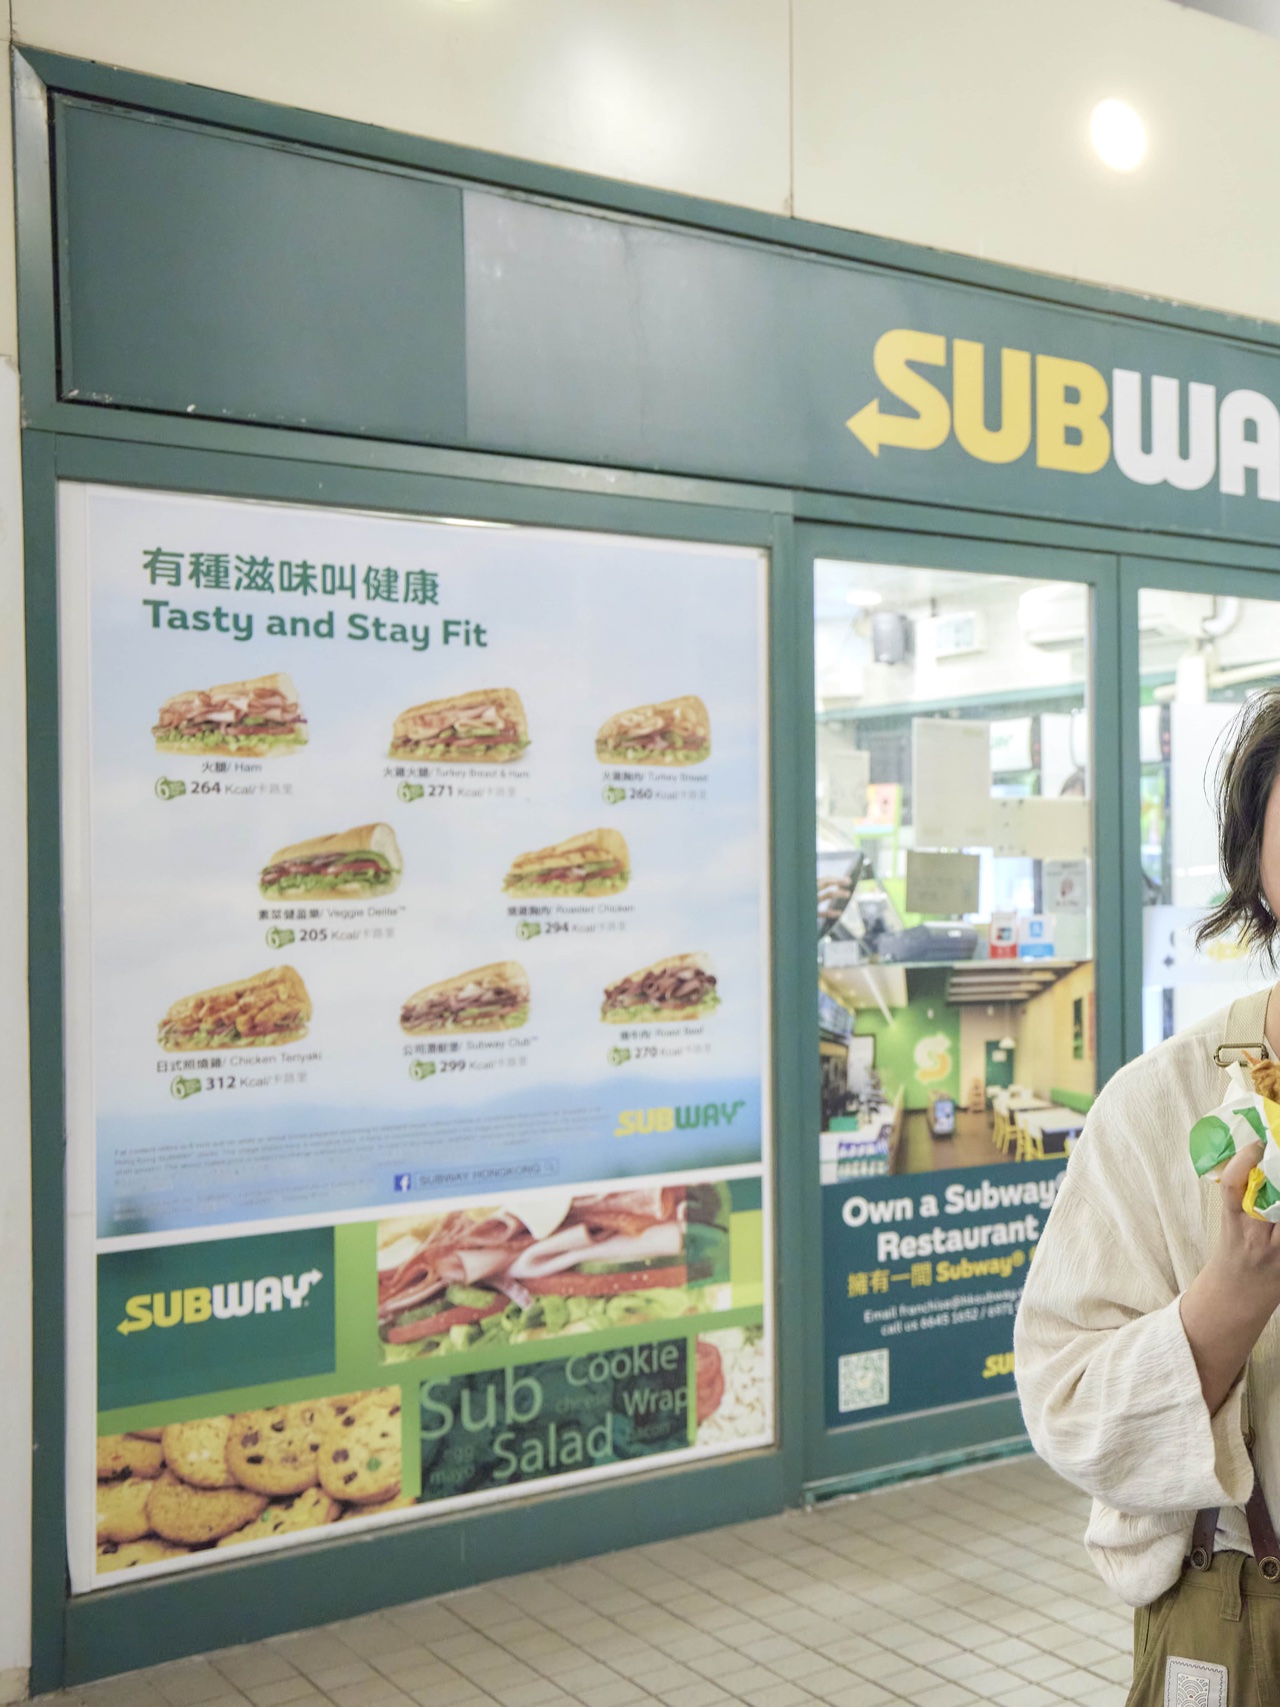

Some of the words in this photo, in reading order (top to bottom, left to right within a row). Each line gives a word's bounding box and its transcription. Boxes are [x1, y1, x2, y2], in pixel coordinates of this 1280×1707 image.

[142, 548, 439, 605] 有種滋味叫健康
[143, 599, 253, 641] Tasty
[266, 611, 334, 639] and
[347, 613, 430, 651] Stay
[443, 620, 488, 647] Fit
[235, 763, 262, 773] Ham
[191, 781, 221, 794] 264
[428, 785, 453, 797] 271
[327, 908, 364, 919] Veggie
[299, 929, 327, 942] 205
[545, 922, 569, 934] 294
[466, 1039, 505, 1051] Subway
[230, 1054, 277, 1067] Chicken
[281, 1051, 323, 1065] Teriyaki
[440, 1059, 466, 1073] 299
[206, 1076, 236, 1091] 312
[613, 1099, 746, 1137] SUBWAY
[419, 1172, 469, 1186] SUBWAY
[473, 1163, 540, 1179] HONGKONG
[842, 1195, 913, 1227] Own
[919, 1194, 939, 1218] a
[877, 1214, 1040, 1262] Restaurant
[116, 1268, 323, 1336] SUBWAY
[863, 1305, 898, 1323] Email
[880, 1321, 903, 1336] call
[904, 1321, 918, 1332] us
[564, 1341, 679, 1388] Cookie
[420, 1366, 543, 1441] Sub
[623, 1385, 688, 1416] Wrap
[492, 1411, 613, 1480] Salad
